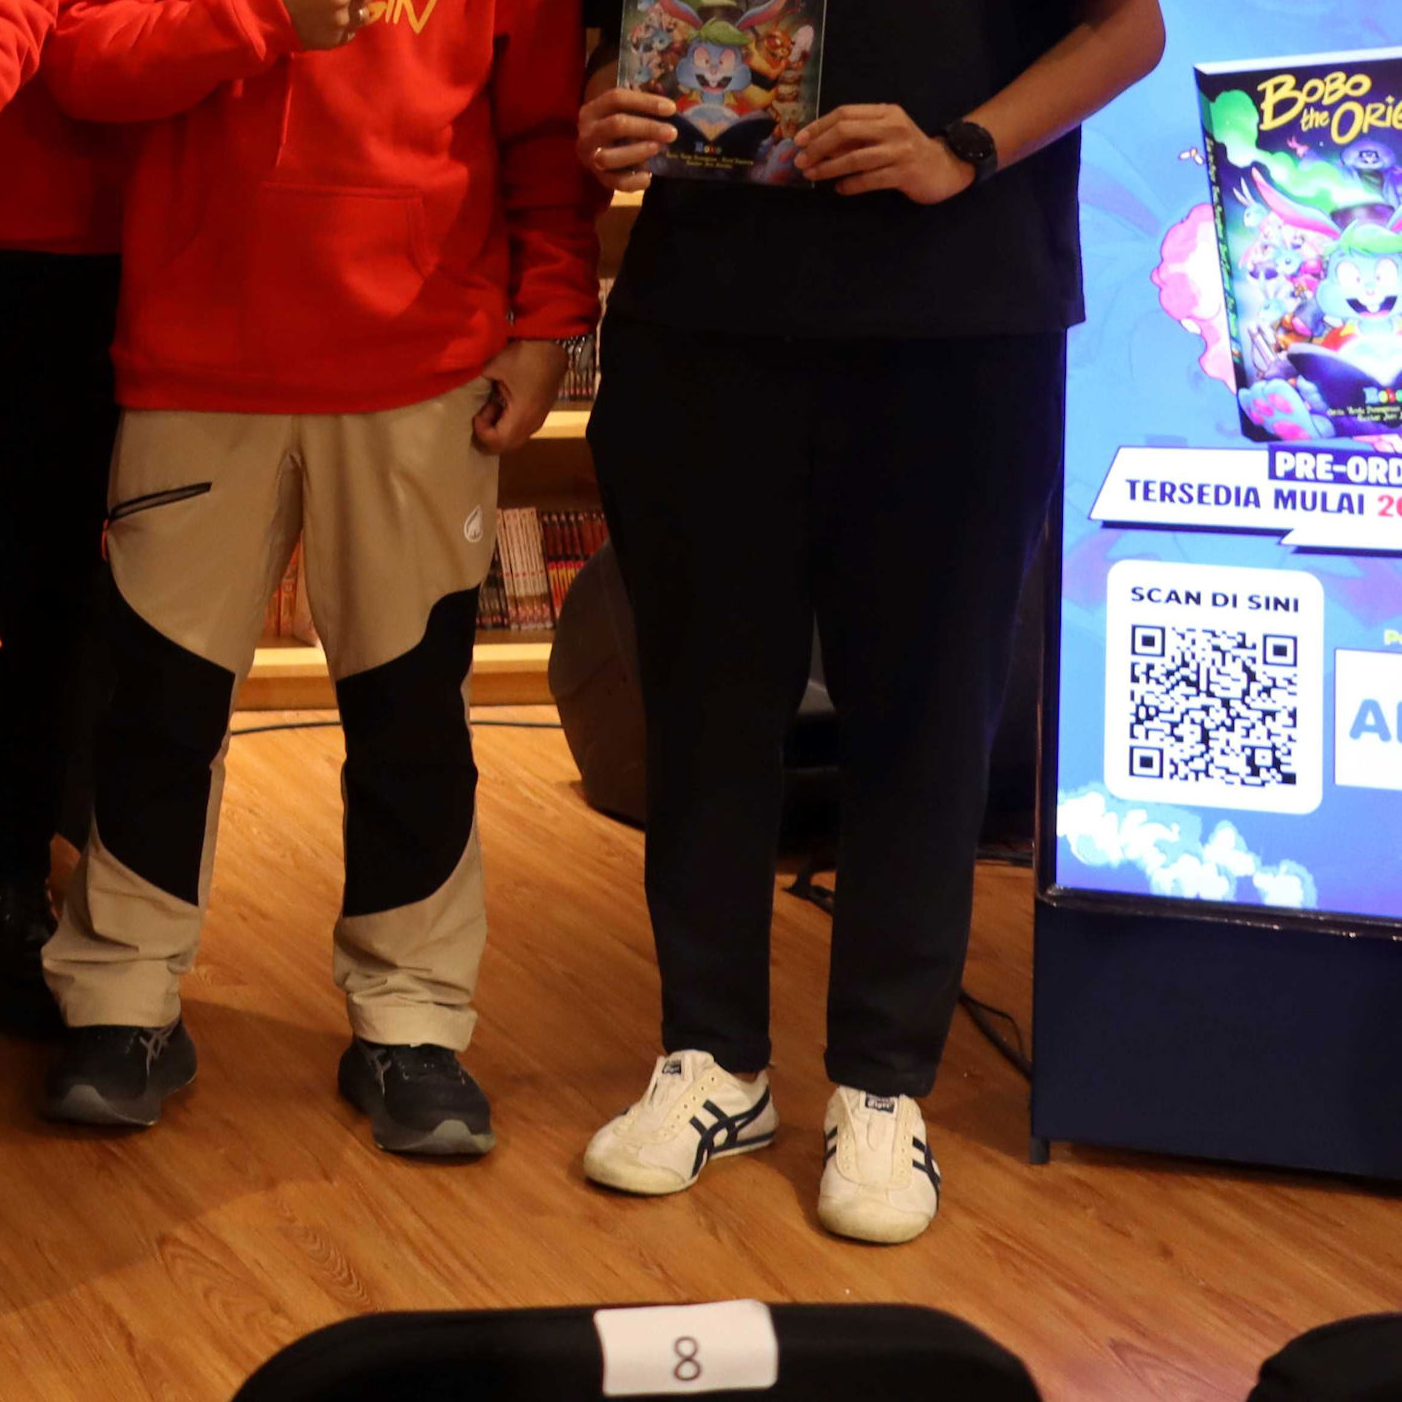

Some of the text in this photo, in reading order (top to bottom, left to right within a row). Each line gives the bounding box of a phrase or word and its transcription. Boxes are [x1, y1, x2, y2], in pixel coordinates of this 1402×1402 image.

[1257, 71, 1373, 131] BOBO
[1300, 107, 1330, 133] the
[1275, 450, 1402, 486] PRE-ORD
[1125, 478, 1261, 509] TERSEDIA
[1273, 487, 1365, 516] MULAI
[1130, 585, 1300, 614] SCAN DI SINI
[1349, 697, 1402, 744] A
[673, 1335, 702, 1382] 8
